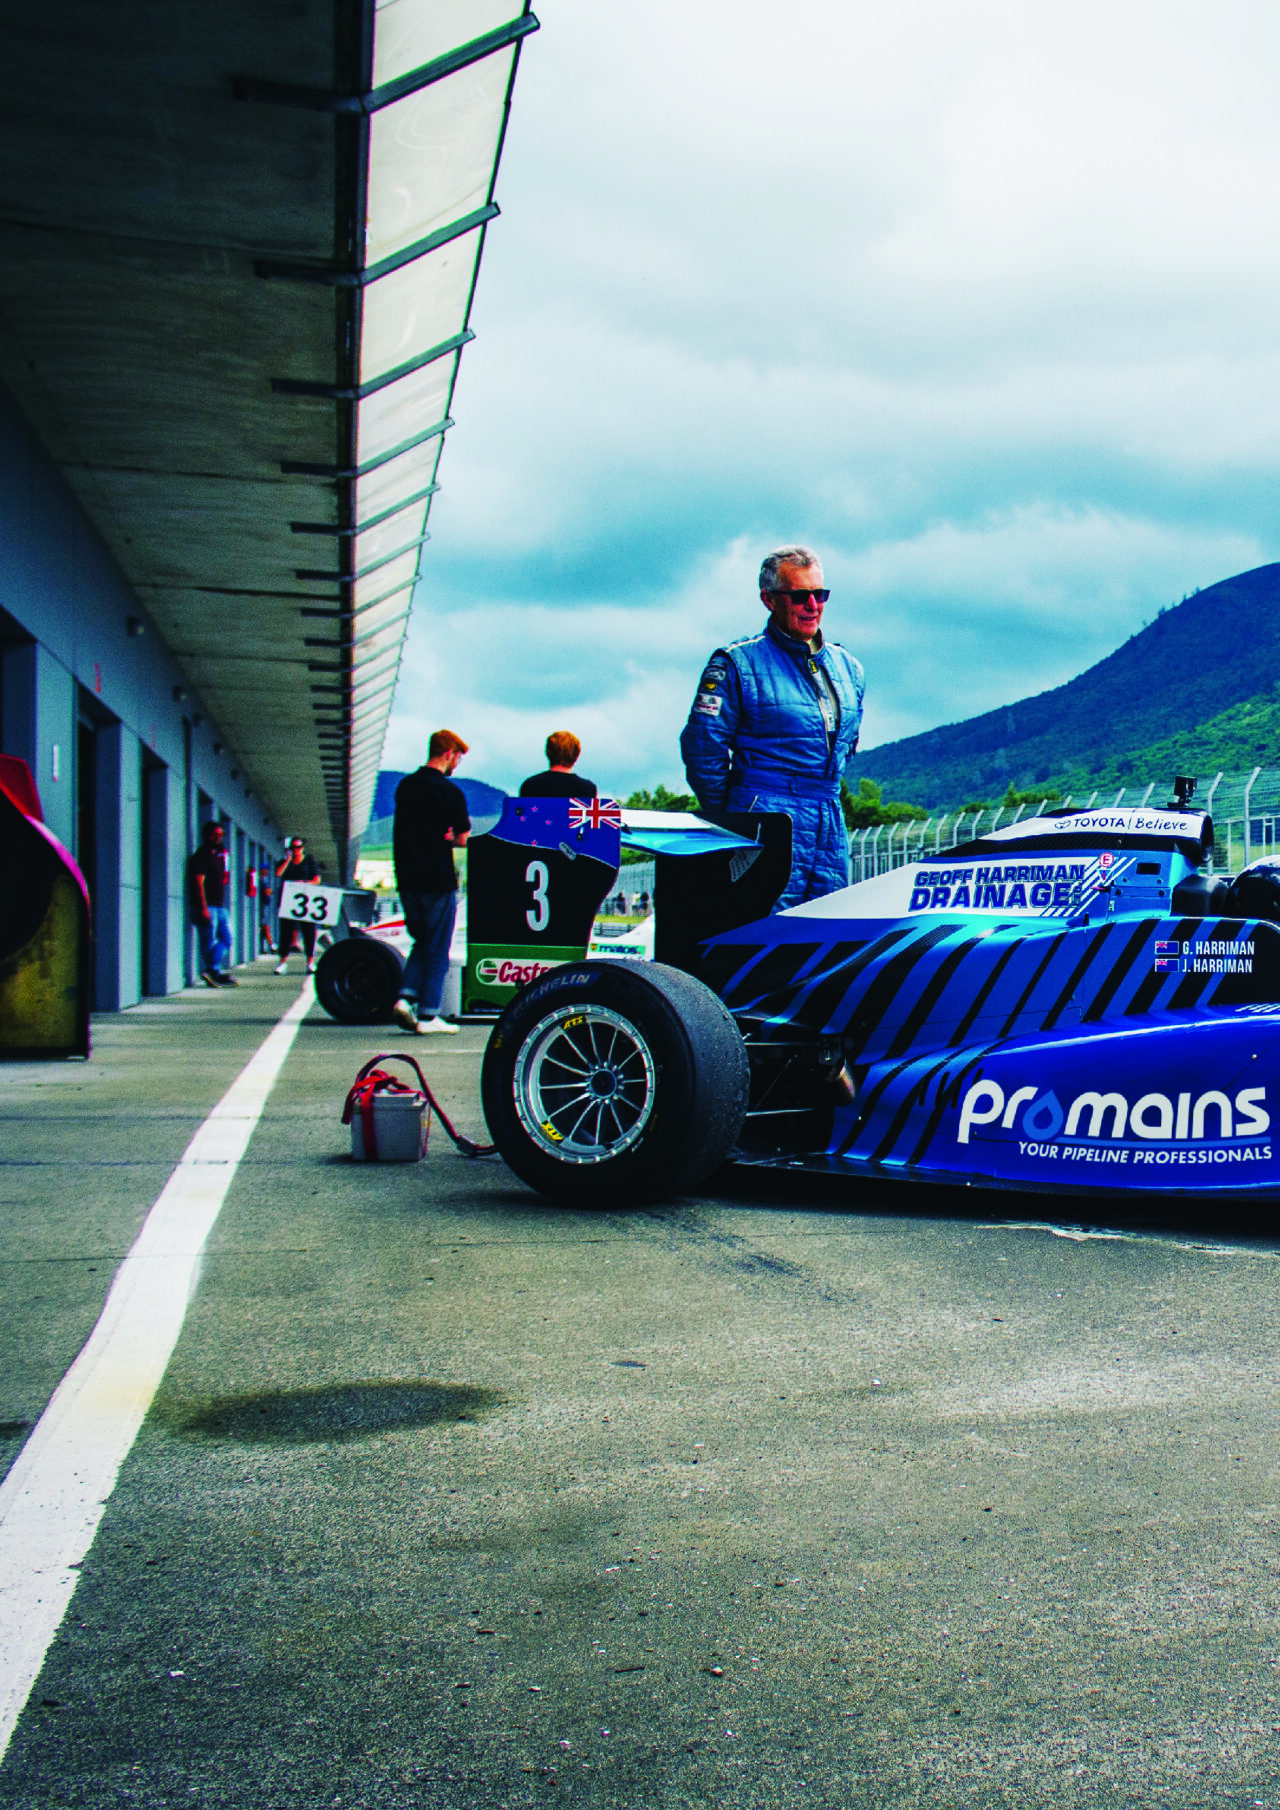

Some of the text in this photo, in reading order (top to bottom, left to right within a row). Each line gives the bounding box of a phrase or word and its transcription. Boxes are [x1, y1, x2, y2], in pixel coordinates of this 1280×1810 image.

[1074, 817, 1188, 832] TOYOTA Believe
[914, 864, 1086, 888] GEOFF HARRIMAN
[290, 892, 328, 921] 33
[525, 860, 550, 932] 3
[908, 881, 1073, 912] DRAINAGE
[1182, 941, 1255, 955] G. HARRIMAN
[1182, 958, 1253, 973] J. HARRIMAN
[563, 1015, 583, 1030] ATS
[1018, 1141, 1273, 1164] YOUR PIPELINE PROFESSIONALS
